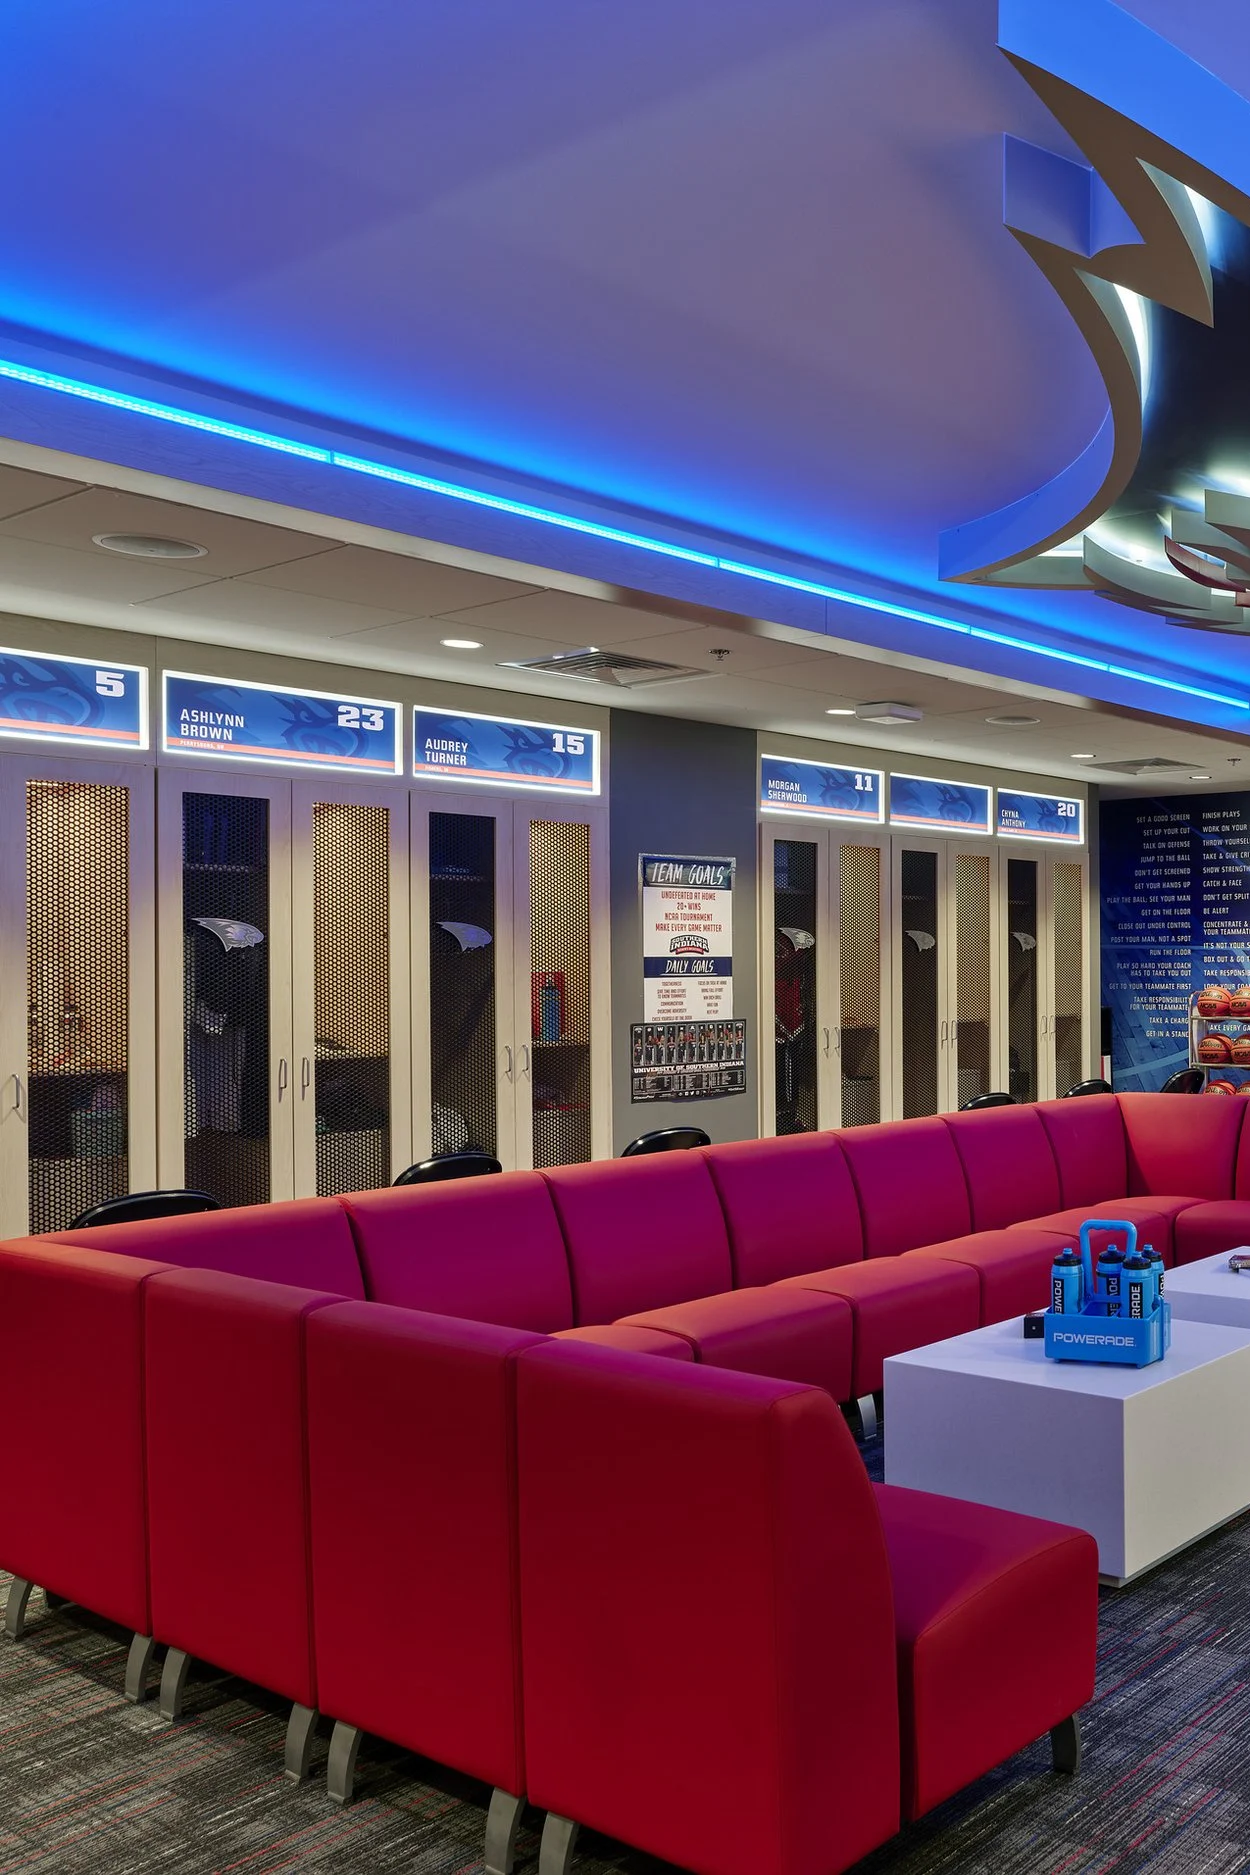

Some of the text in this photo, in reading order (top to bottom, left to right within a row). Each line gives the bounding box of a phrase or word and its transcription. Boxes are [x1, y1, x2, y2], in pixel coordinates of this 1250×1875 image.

[96, 670, 124, 697] 5
[180, 709, 244, 727] ASHLYNN
[337, 705, 384, 731] 23
[181, 724, 232, 741] BROWN
[425, 738, 468, 753] AUDREY
[552, 733, 584, 755] 15
[425, 751, 467, 766] TURNER
[768, 780, 800, 791] MORGAN
[854, 774, 873, 792] 11
[768, 790, 807, 803] SHERWOOD
[1002, 810, 1019, 818] CHYNA
[1058, 802, 1075, 817] 20
[1002, 819, 1026, 828] ANTHONY
[652, 863, 724, 885] TEAM GOALS
[661, 891, 693, 900] UNDEFEATED
[680, 913, 713, 921] TOURNAMENT
[671, 941, 709, 950] INDIANA
[666, 960, 714, 973] DAILY GOALS
[634, 1066, 674, 1074] UNIVERSITY
[1054, 1332, 1135, 1347] POWERADE
